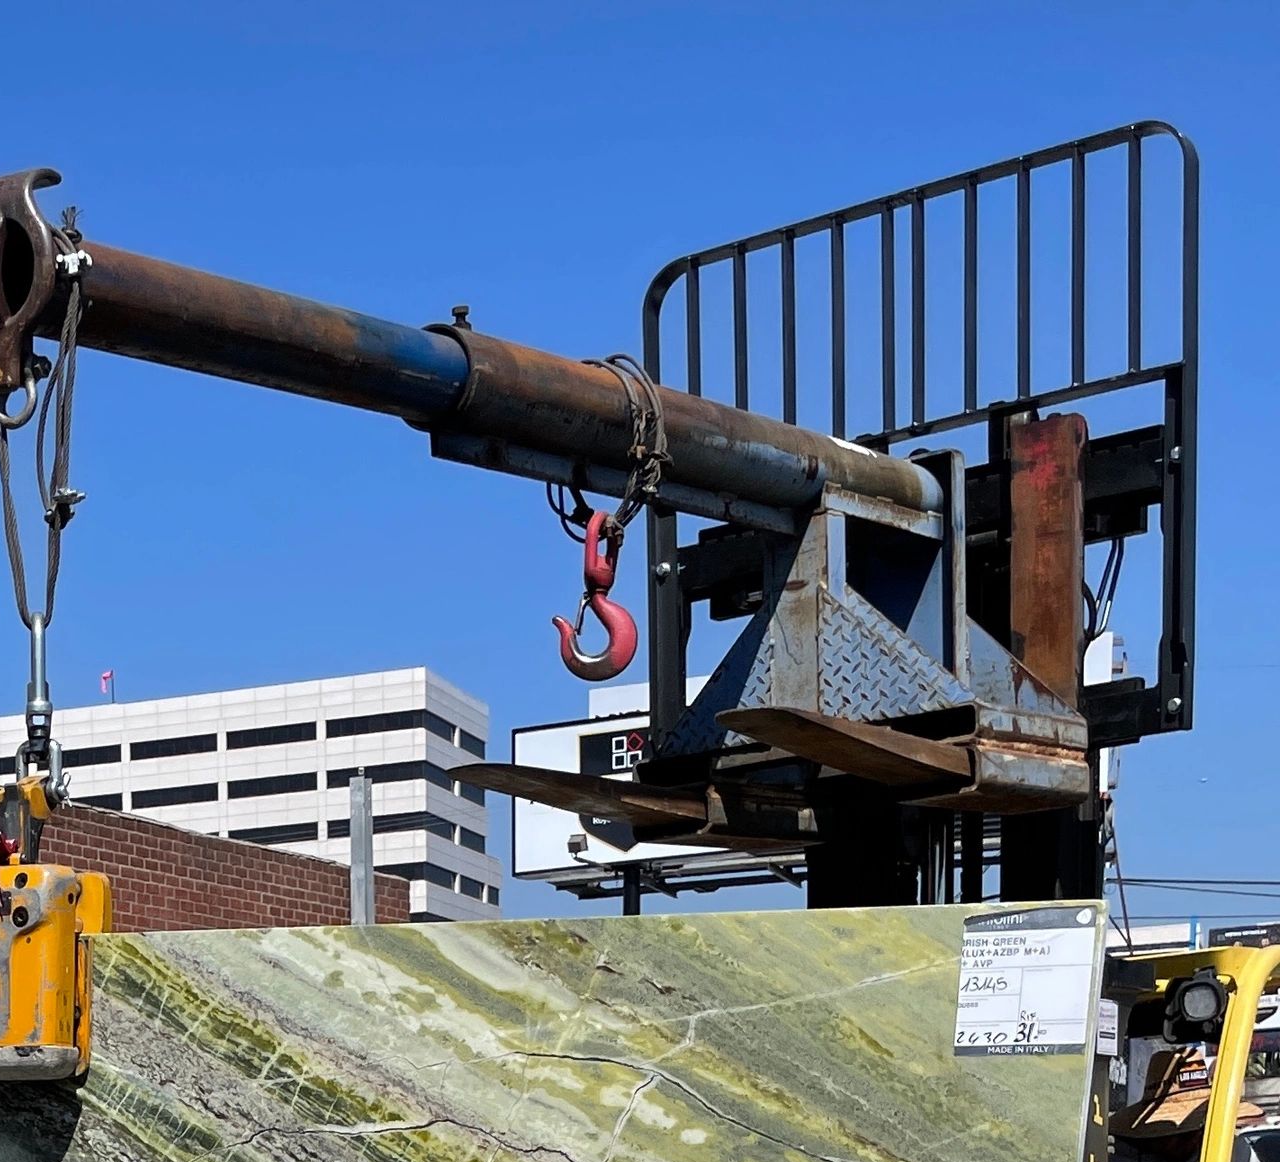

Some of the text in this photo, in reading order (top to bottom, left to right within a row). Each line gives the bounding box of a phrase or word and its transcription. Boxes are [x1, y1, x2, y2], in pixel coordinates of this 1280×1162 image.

[992, 936, 1027, 947] GREEN
[972, 959, 993, 968] AVP
[987, 1045, 1050, 1055] MADE IN ITALY
